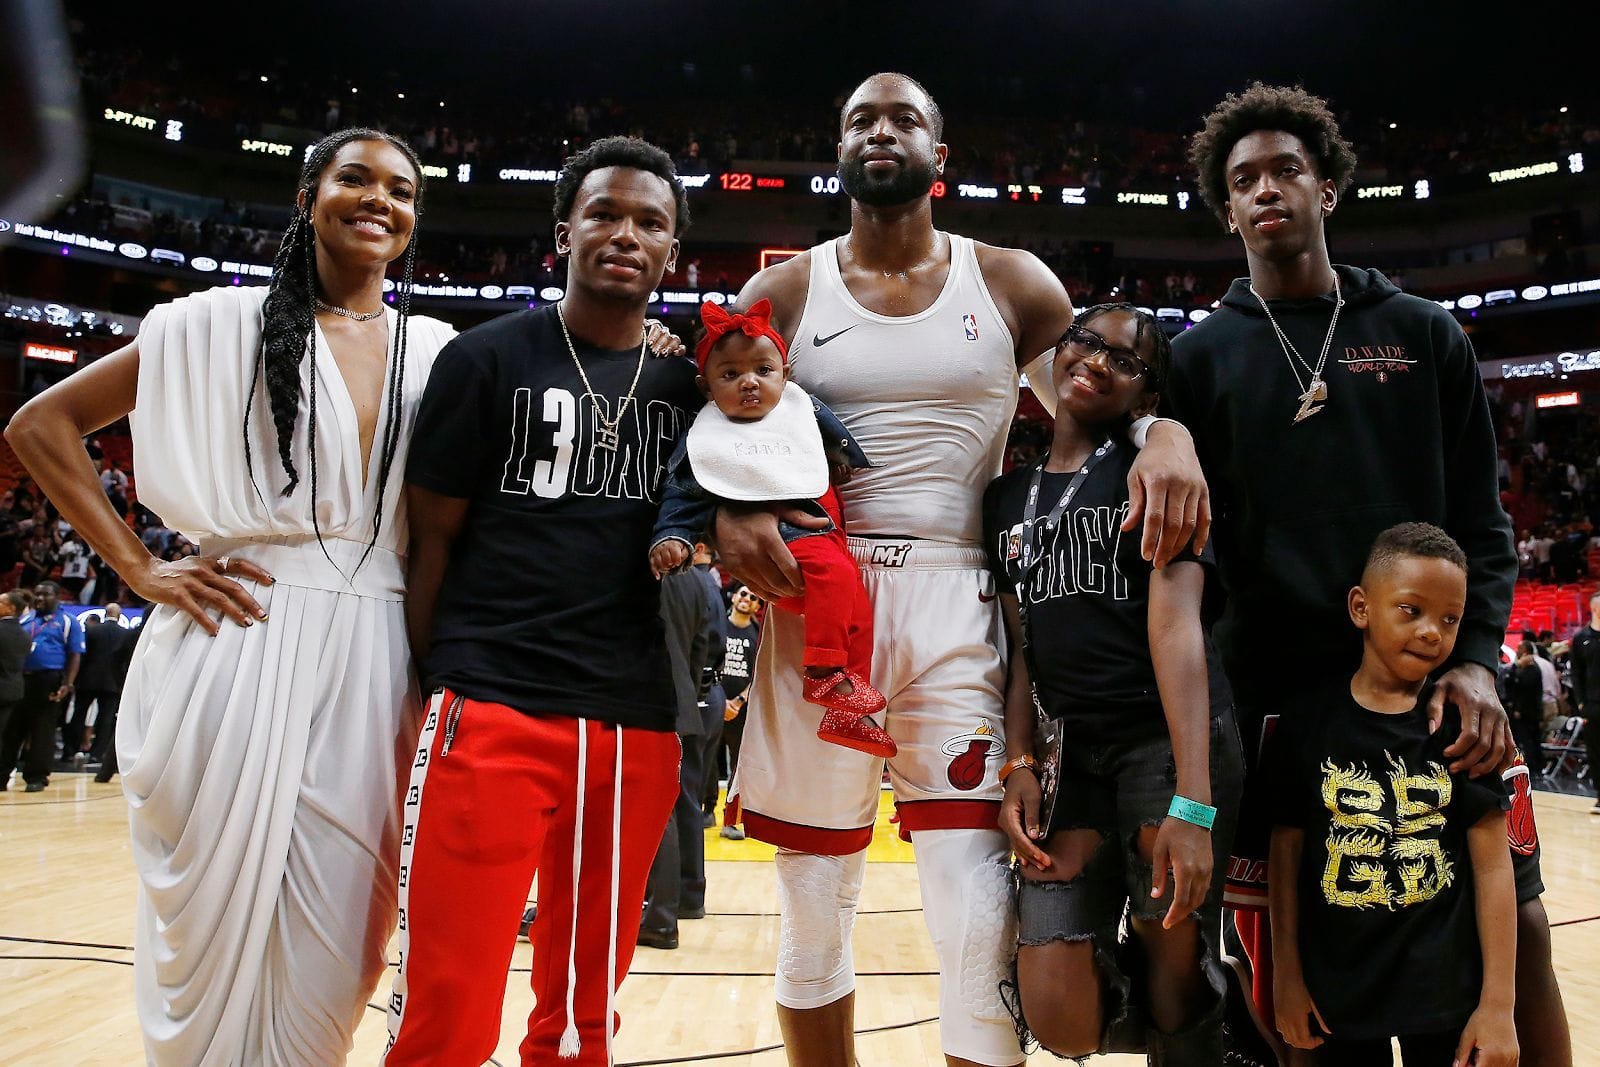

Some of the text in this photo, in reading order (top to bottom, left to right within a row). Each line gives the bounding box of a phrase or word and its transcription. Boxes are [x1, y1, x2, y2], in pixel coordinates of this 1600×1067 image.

[104, 108, 157, 131] 3-PT ATT
[241, 139, 268, 153] 3-PT
[268, 143, 293, 156] PCT
[499, 169, 557, 182] OFFENSIVE
[1489, 162, 1558, 183] TURNOVERS
[720, 173, 752, 190] 122
[810, 175, 840, 194] 0.0
[929, 181, 946, 198] 9
[958, 184, 998, 198] 76ers
[1357, 185, 1403, 199] 3-PT PCT
[1117, 192, 1168, 205] 3-PT MADE
[53, 230, 76, 245] Local
[1347, 361, 1410, 374] WORLD TOUR
[500, 387, 687, 506] L3GAC
